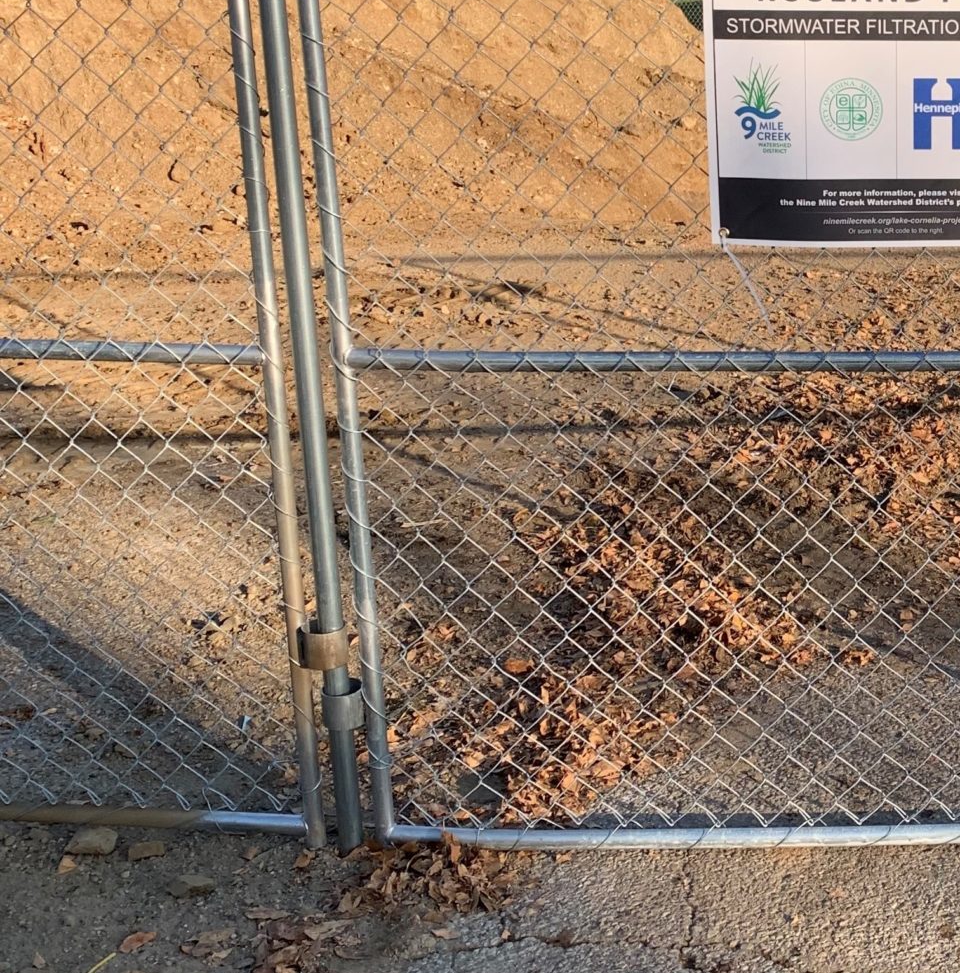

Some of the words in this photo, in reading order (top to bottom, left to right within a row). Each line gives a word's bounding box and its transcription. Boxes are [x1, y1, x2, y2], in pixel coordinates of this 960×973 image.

[726, 18, 860, 35] STORMWATER
[741, 116, 756, 139] 9
[759, 122, 783, 130] MILE
[757, 132, 791, 141] CREEK
[864, 189, 916, 198] information,
[918, 189, 947, 198] please
